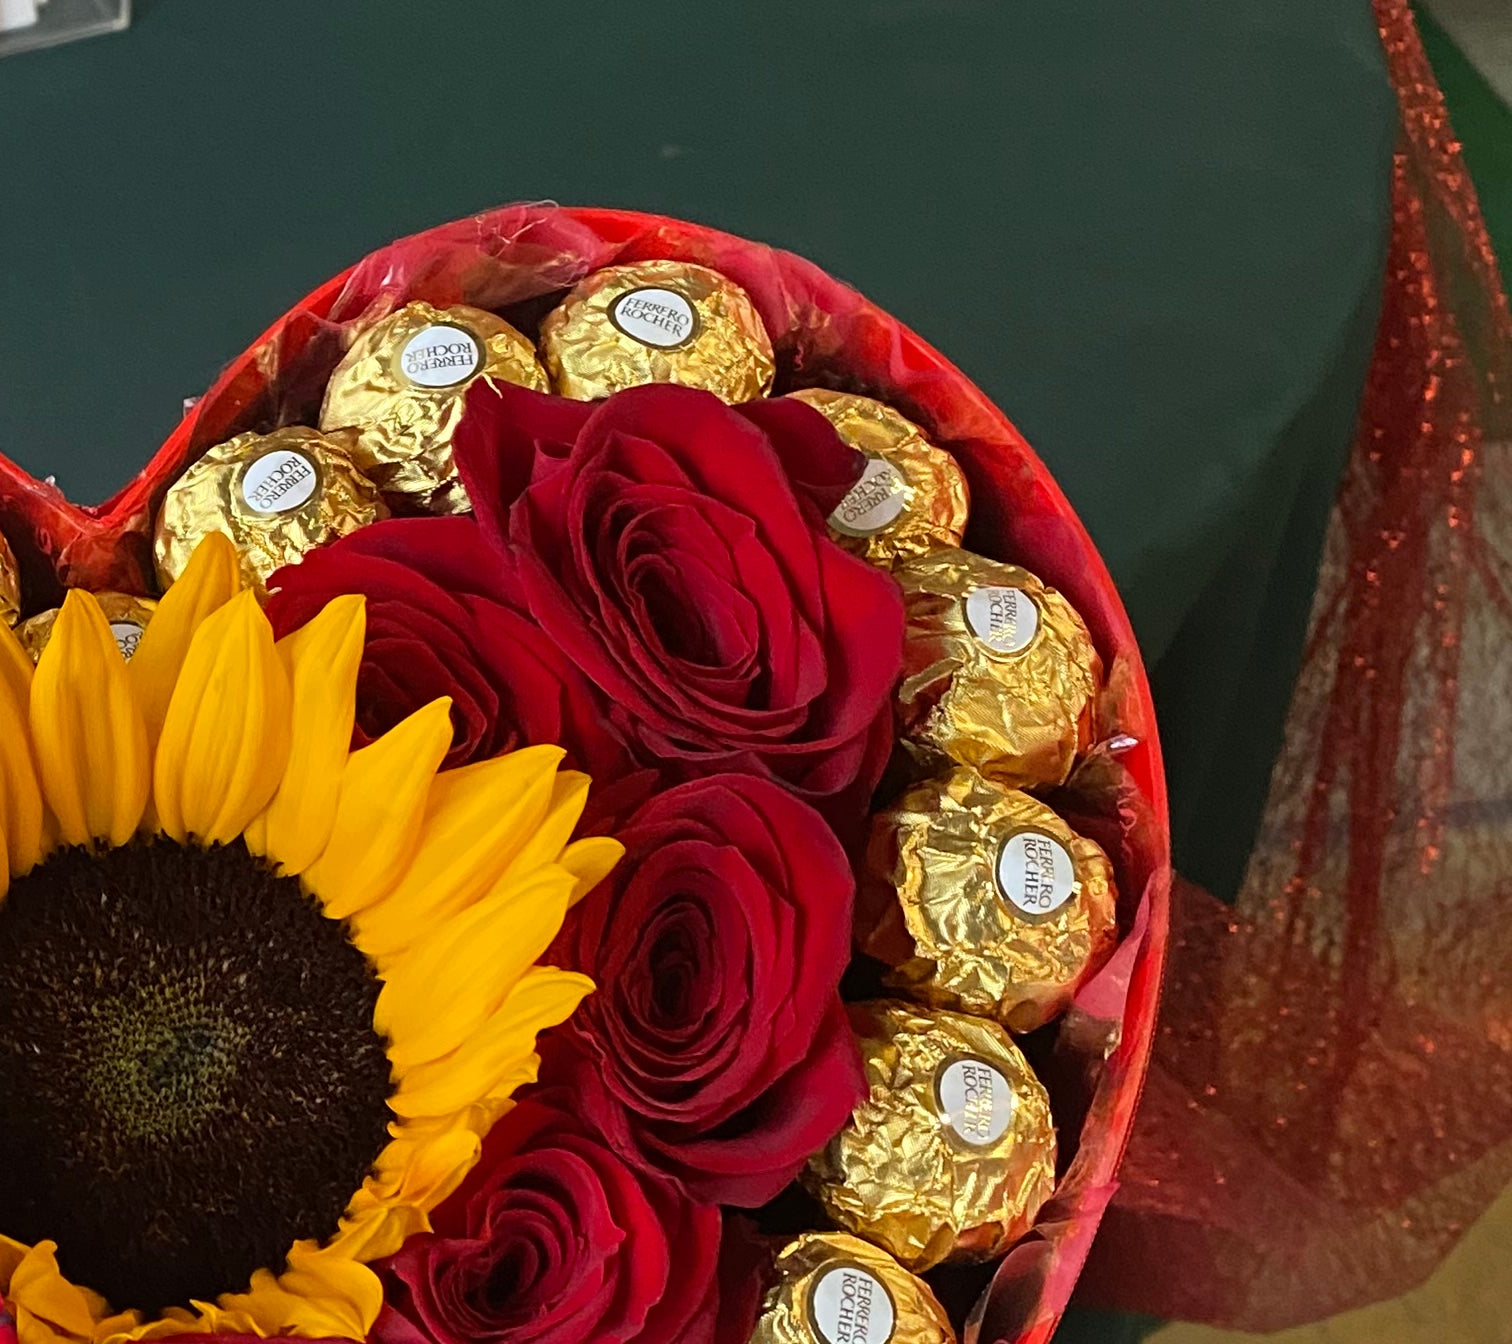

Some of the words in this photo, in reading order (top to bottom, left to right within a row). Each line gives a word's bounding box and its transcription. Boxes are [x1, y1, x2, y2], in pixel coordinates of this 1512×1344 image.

[620, 306, 683, 337] ROCHER
[626, 297, 689, 327] FERRERO
[406, 342, 472, 362] ROCHER
[407, 355, 473, 374] FERRERO
[249, 456, 302, 502] ROCHER
[259, 465, 311, 510] FERRERO
[1023, 838, 1039, 906] ROCHER
[1037, 839, 1053, 909] FERRERO
[837, 1273, 859, 1343] ROCHER
